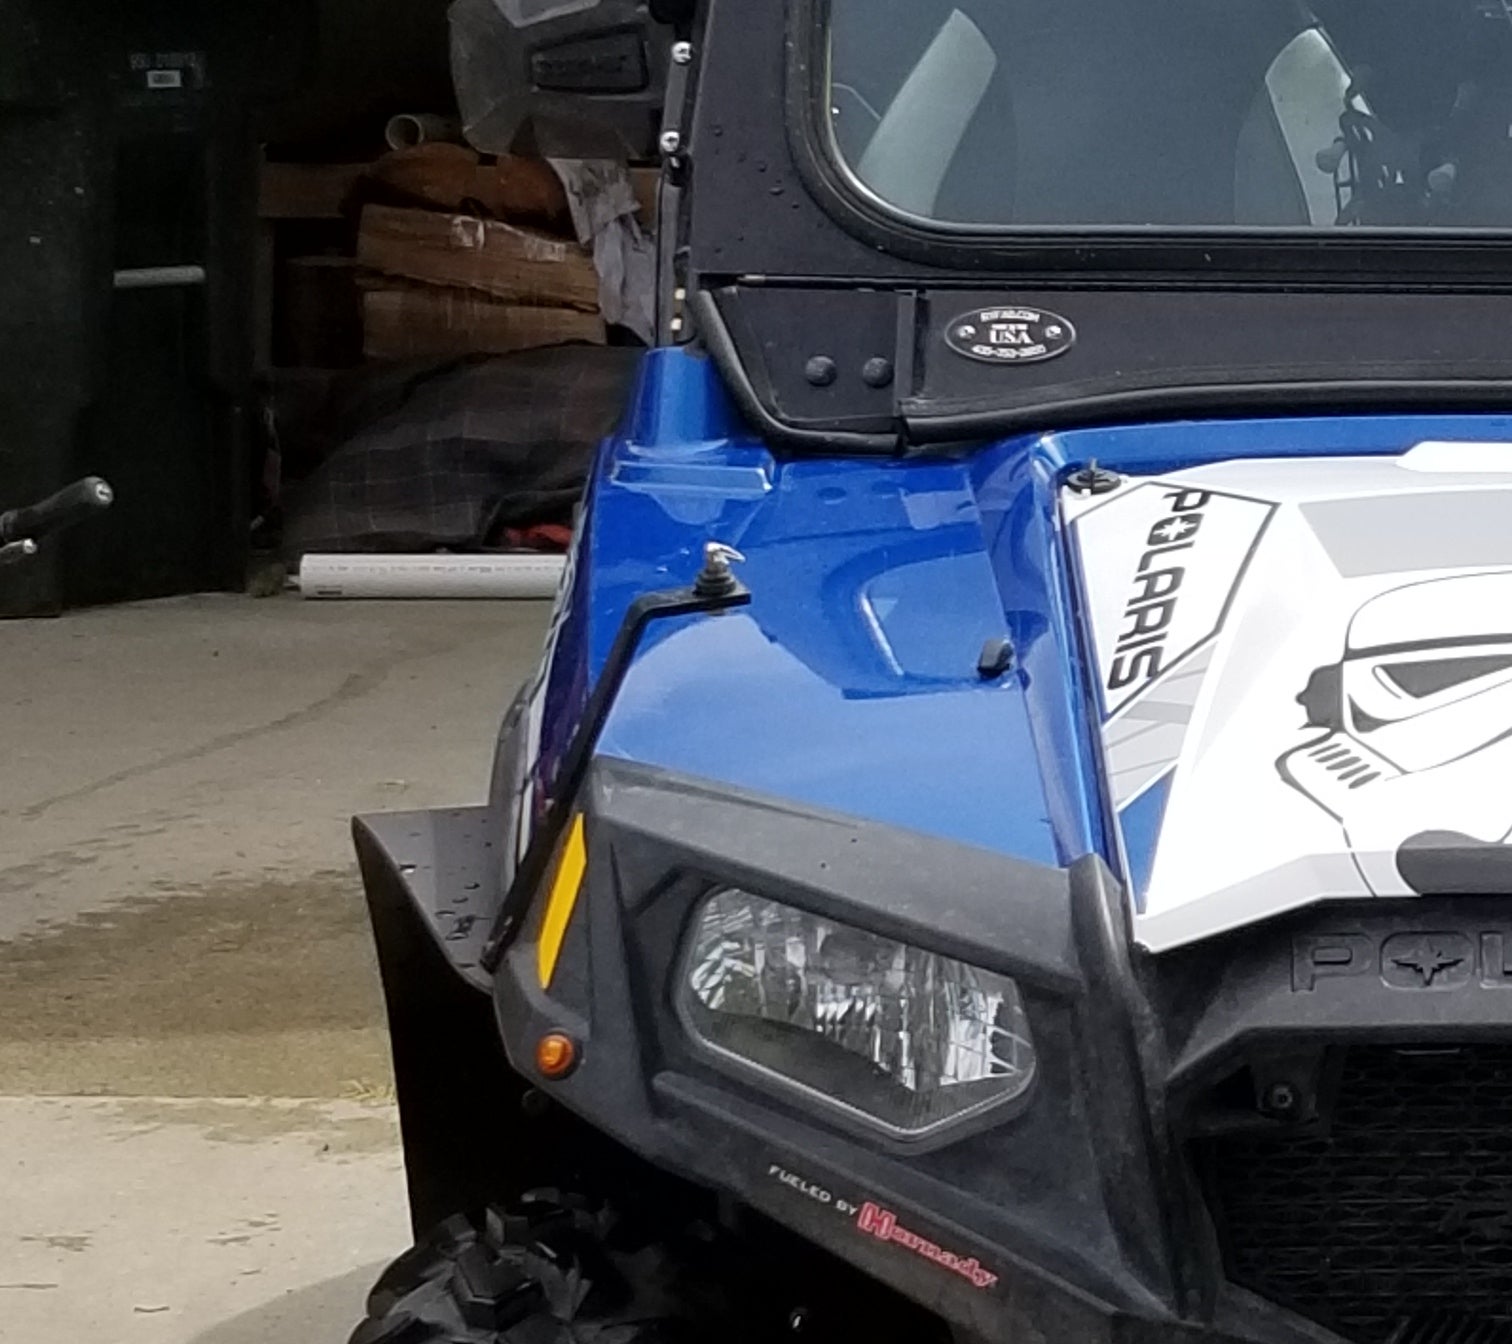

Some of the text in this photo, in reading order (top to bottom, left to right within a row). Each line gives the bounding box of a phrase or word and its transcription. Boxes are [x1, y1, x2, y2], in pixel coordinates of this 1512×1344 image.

[990, 330, 1035, 344] USA
[1106, 488, 1212, 690] POLARIS
[768, 1164, 999, 1287] FUELED BY Hornady
